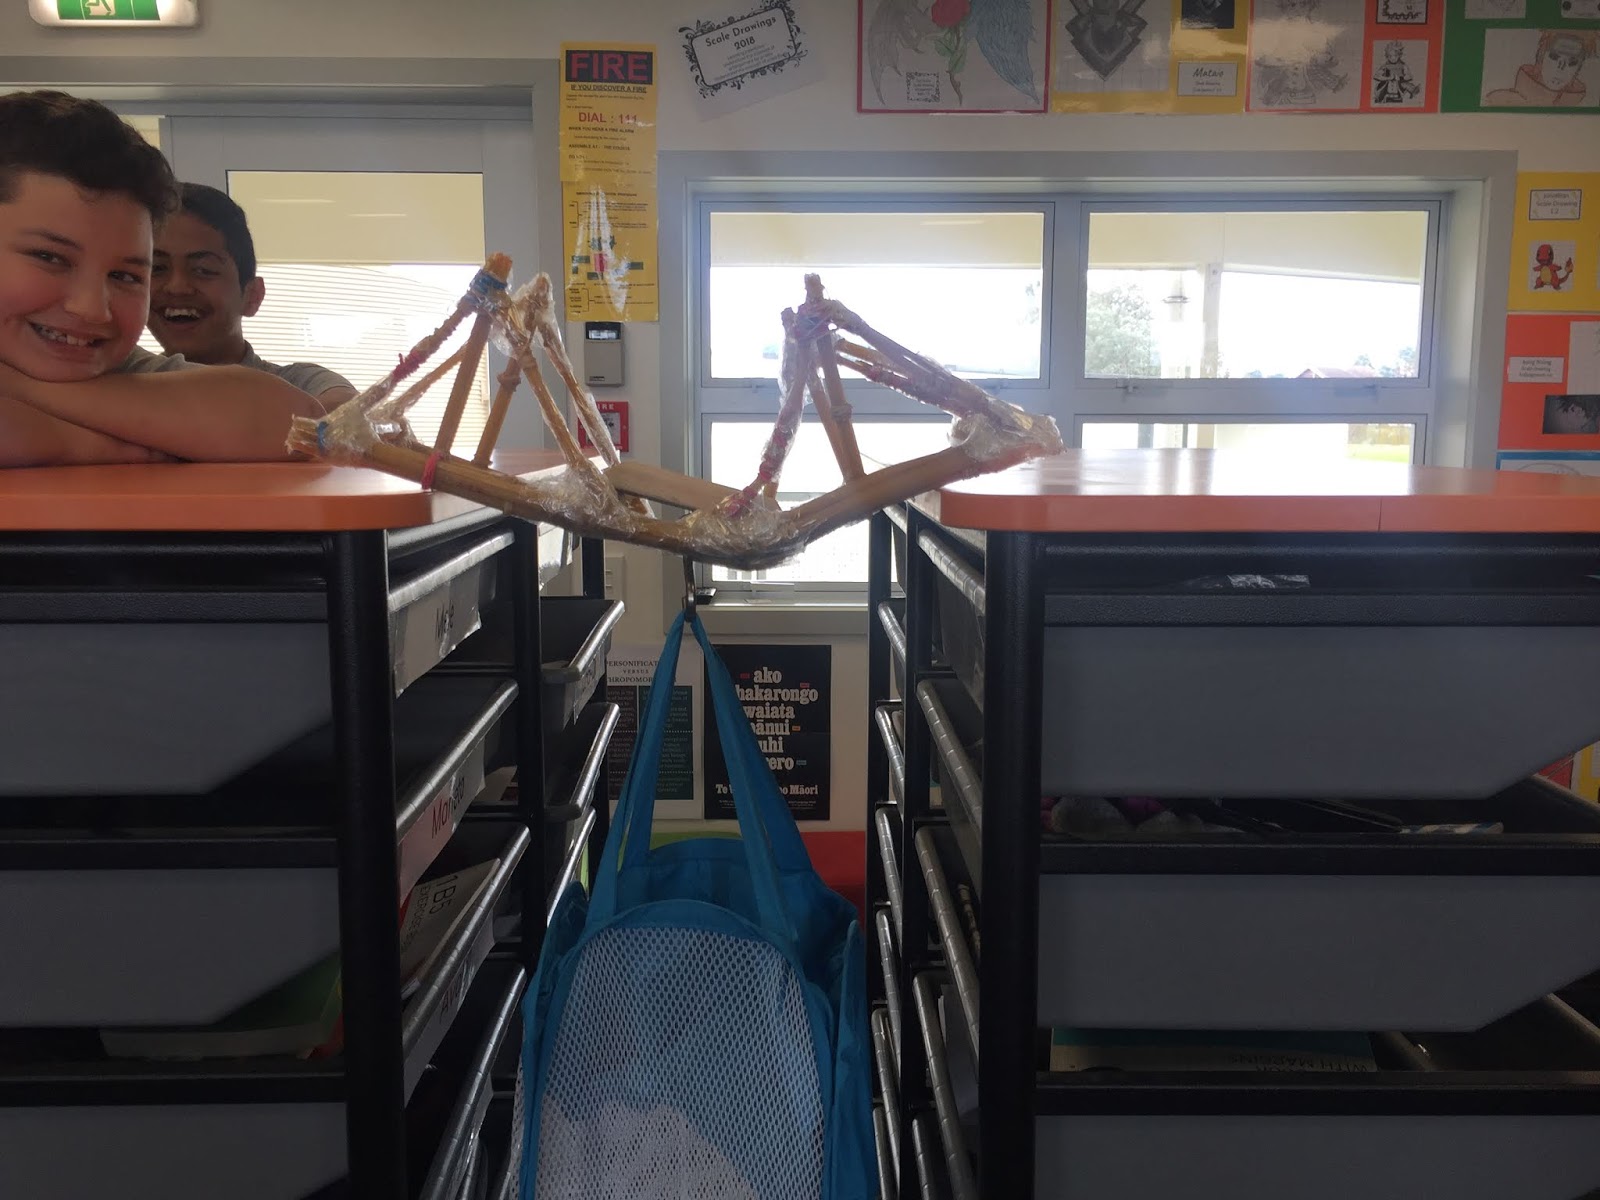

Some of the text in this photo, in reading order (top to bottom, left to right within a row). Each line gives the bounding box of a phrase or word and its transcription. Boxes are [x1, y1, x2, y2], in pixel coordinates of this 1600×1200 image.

[705, 16, 777, 47] Scale Drawings
[734, 36, 756, 50] 2018
[571, 52, 648, 81] FIRE
[578, 112, 607, 123] DIAL
[618, 114, 637, 124] 111
[753, 666, 782, 684] ako
[735, 684, 819, 705] hakarongo
[743, 702, 795, 719] waiata
[758, 736, 784, 753] uhi
[766, 757, 794, 770] ero
[716, 784, 728, 794] Te
[789, 783, 818, 795] Māori
[429, 875, 458, 914] 1B5
